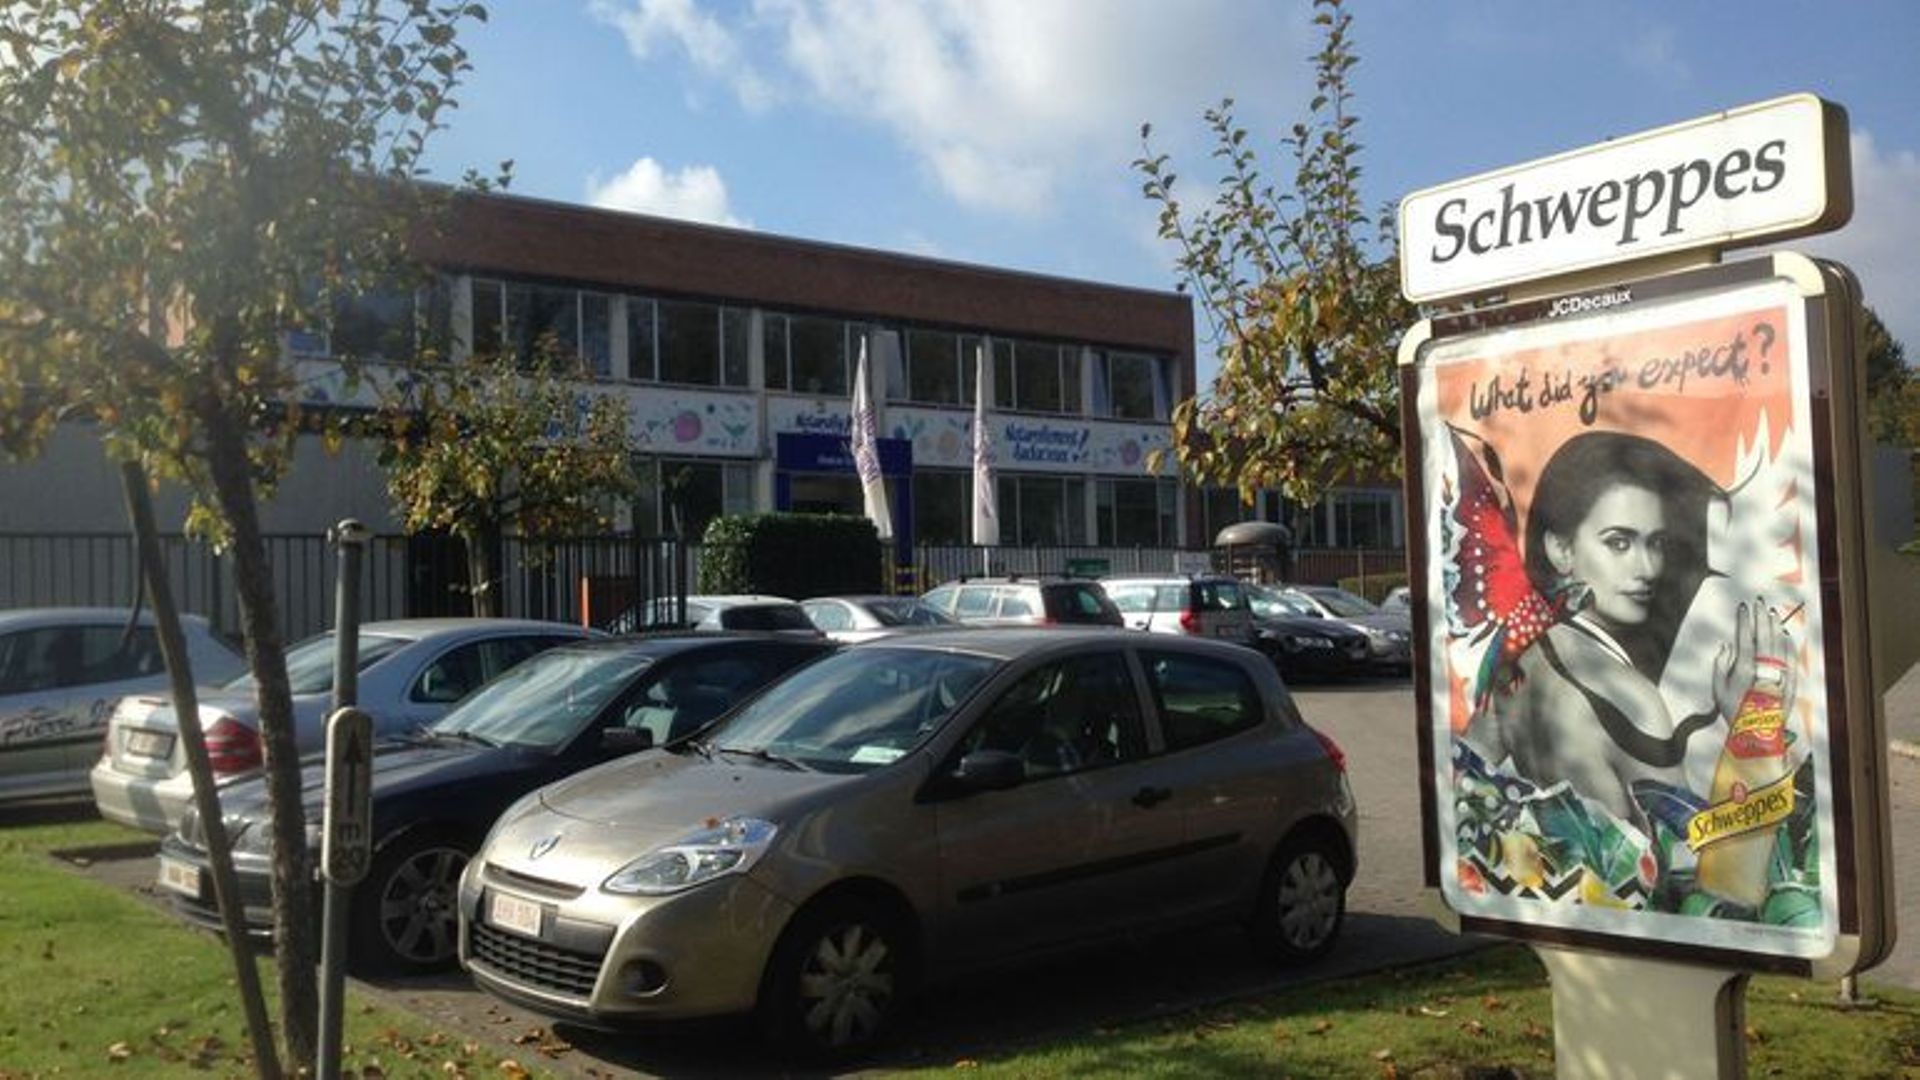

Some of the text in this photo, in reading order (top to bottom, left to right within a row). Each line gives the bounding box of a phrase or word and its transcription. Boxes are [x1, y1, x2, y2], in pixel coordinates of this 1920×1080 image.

[1431, 138, 1787, 263] Schweppes
[1547, 289, 1632, 317] JCDecaux
[1470, 368, 1533, 420] What
[1539, 369, 1573, 408] did
[1577, 370, 1628, 426] you
[1694, 790, 1788, 840] Schweppes
